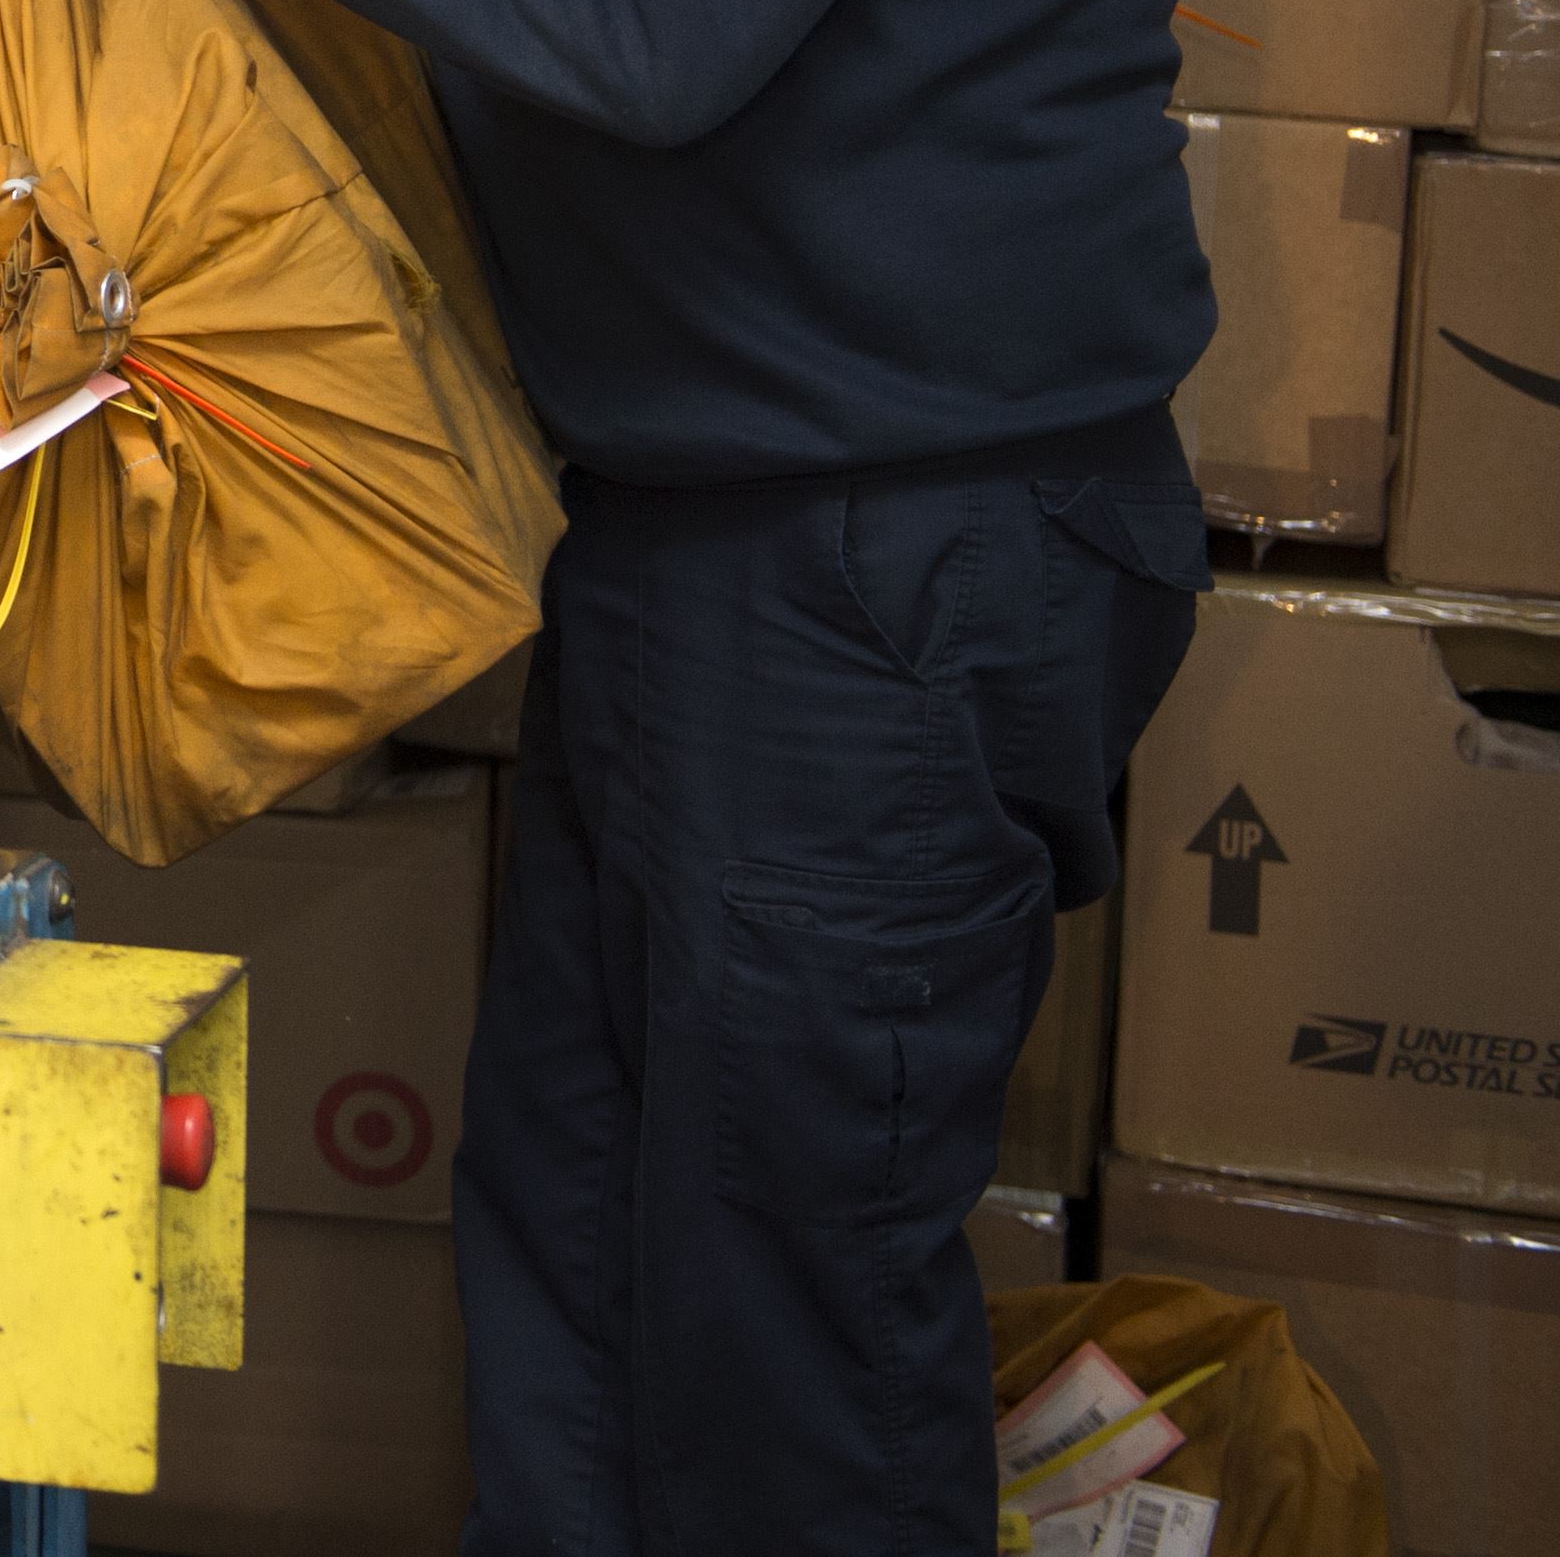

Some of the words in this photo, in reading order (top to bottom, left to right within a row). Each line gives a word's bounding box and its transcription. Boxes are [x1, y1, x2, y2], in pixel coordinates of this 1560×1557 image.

[1218, 819, 1264, 861] UP
[1395, 1023, 1539, 1065] UNITED
[1387, 1054, 1523, 1097] POSTAL
